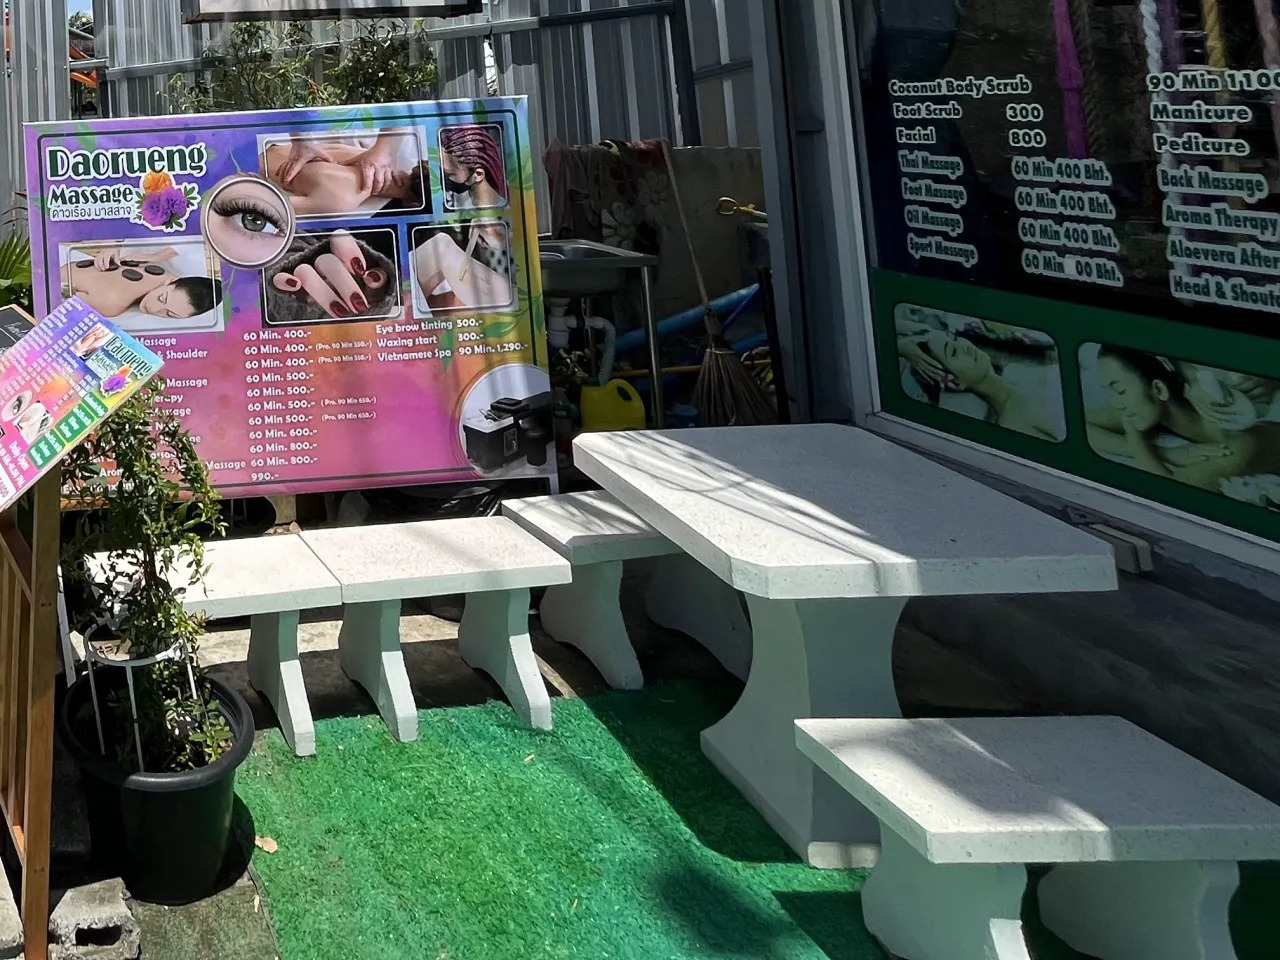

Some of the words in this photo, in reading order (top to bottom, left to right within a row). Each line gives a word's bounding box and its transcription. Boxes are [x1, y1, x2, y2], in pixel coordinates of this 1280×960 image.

[891, 79, 942, 94] Coconut
[945, 78, 982, 97] Body
[986, 76, 1030, 92] Scrub
[1149, 74, 1175, 89] 90
[1182, 73, 1219, 89] Min
[895, 103, 921, 116] Foot
[925, 103, 960, 116] Scrub
[1008, 105, 1041, 119] 300
[1152, 103, 1249, 120] Manicure
[898, 128, 934, 142] Facial
[1011, 131, 1044, 144] 800
[1156, 135, 1246, 153] Pedicure
[48, 144, 205, 177] Daorueng
[900, 154, 919, 169] Thai
[922, 154, 961, 175] Massage
[1014, 160, 1029, 175] 60
[1033, 159, 1053, 177] Min
[1056, 162, 1081, 178] 400
[1084, 163, 1109, 181] Bht.
[1161, 169, 1194, 188] Back
[1198, 171, 1264, 198] Massage
[50, 186, 133, 205] Massage
[904, 181, 922, 196] Foot
[925, 182, 964, 204] Massage
[1018, 191, 1032, 206] 60
[1036, 192, 1057, 208] Min
[1060, 194, 1084, 211] 400
[906, 208, 919, 224] Oil
[922, 209, 960, 232] Massage
[1021, 222, 1036, 238] 60
[1039, 223, 1060, 240] Min
[1064, 226, 1088, 244] 400
[1092, 229, 1116, 248] Bht.
[1166, 204, 1212, 225] Aroma
[1214, 207, 1277, 237] Therapy
[909, 237, 933, 255] Sport
[935, 239, 975, 263] Massage
[1025, 253, 1039, 270] 60
[1043, 255, 1064, 273] Min
[1170, 239, 1236, 264] Aloevera
[1173, 275, 1210, 297] Head
[1215, 281, 1228, 300] &
[376, 325, 393, 334] Eye
[395, 323, 419, 332] brow
[421, 320, 453, 330] tinting
[457, 319, 483, 328] 500.-
[243, 332, 257, 340] 60
[259, 331, 281, 340] Min.
[284, 330, 312, 338] 400.-
[376, 338, 413, 348] Waxing
[415, 336, 438, 344] start
[457, 333, 484, 342] 300.-
[166, 350, 208, 359] Shoulder
[260, 345, 282, 354] Min.
[285, 344, 312, 352] 400.-
[377, 351, 432, 362] Vietnamese
[434, 348, 452, 358] Spa
[459, 347, 472, 355] 90
[474, 345, 495, 354] Min.
[497, 342, 528, 353] 1,290.-
[245, 361, 259, 369] 60
[261, 359, 283, 368] Min.
[286, 358, 314, 366] 400.-
[166, 378, 208, 388] Massage
[246, 375, 259, 383] 60
[262, 373, 284, 382] Min.
[286, 372, 314, 380] 500.-
[247, 389, 260, 397] 60
[263, 387, 285, 396] Min.
[287, 386, 315, 395] 500.-
[248, 403, 261, 411] 60
[264, 401, 285, 410] Min.
[288, 400, 315, 408] 500.-
[249, 417, 262, 425] 60
[265, 415, 283, 424] Min
[286, 415, 313, 423] 500.-
[249, 431, 262, 439] 60
[265, 429, 287, 438] Min.
[290, 428, 317, 436] 600.-
[250, 445, 263, 453] 60
[266, 443, 288, 452] Min.
[290, 442, 318, 450] 800.-
[251, 459, 264, 467] 60
[266, 457, 288, 466] Min.
[291, 456, 318, 464] 800.-
[251, 473, 279, 481] 990.-
